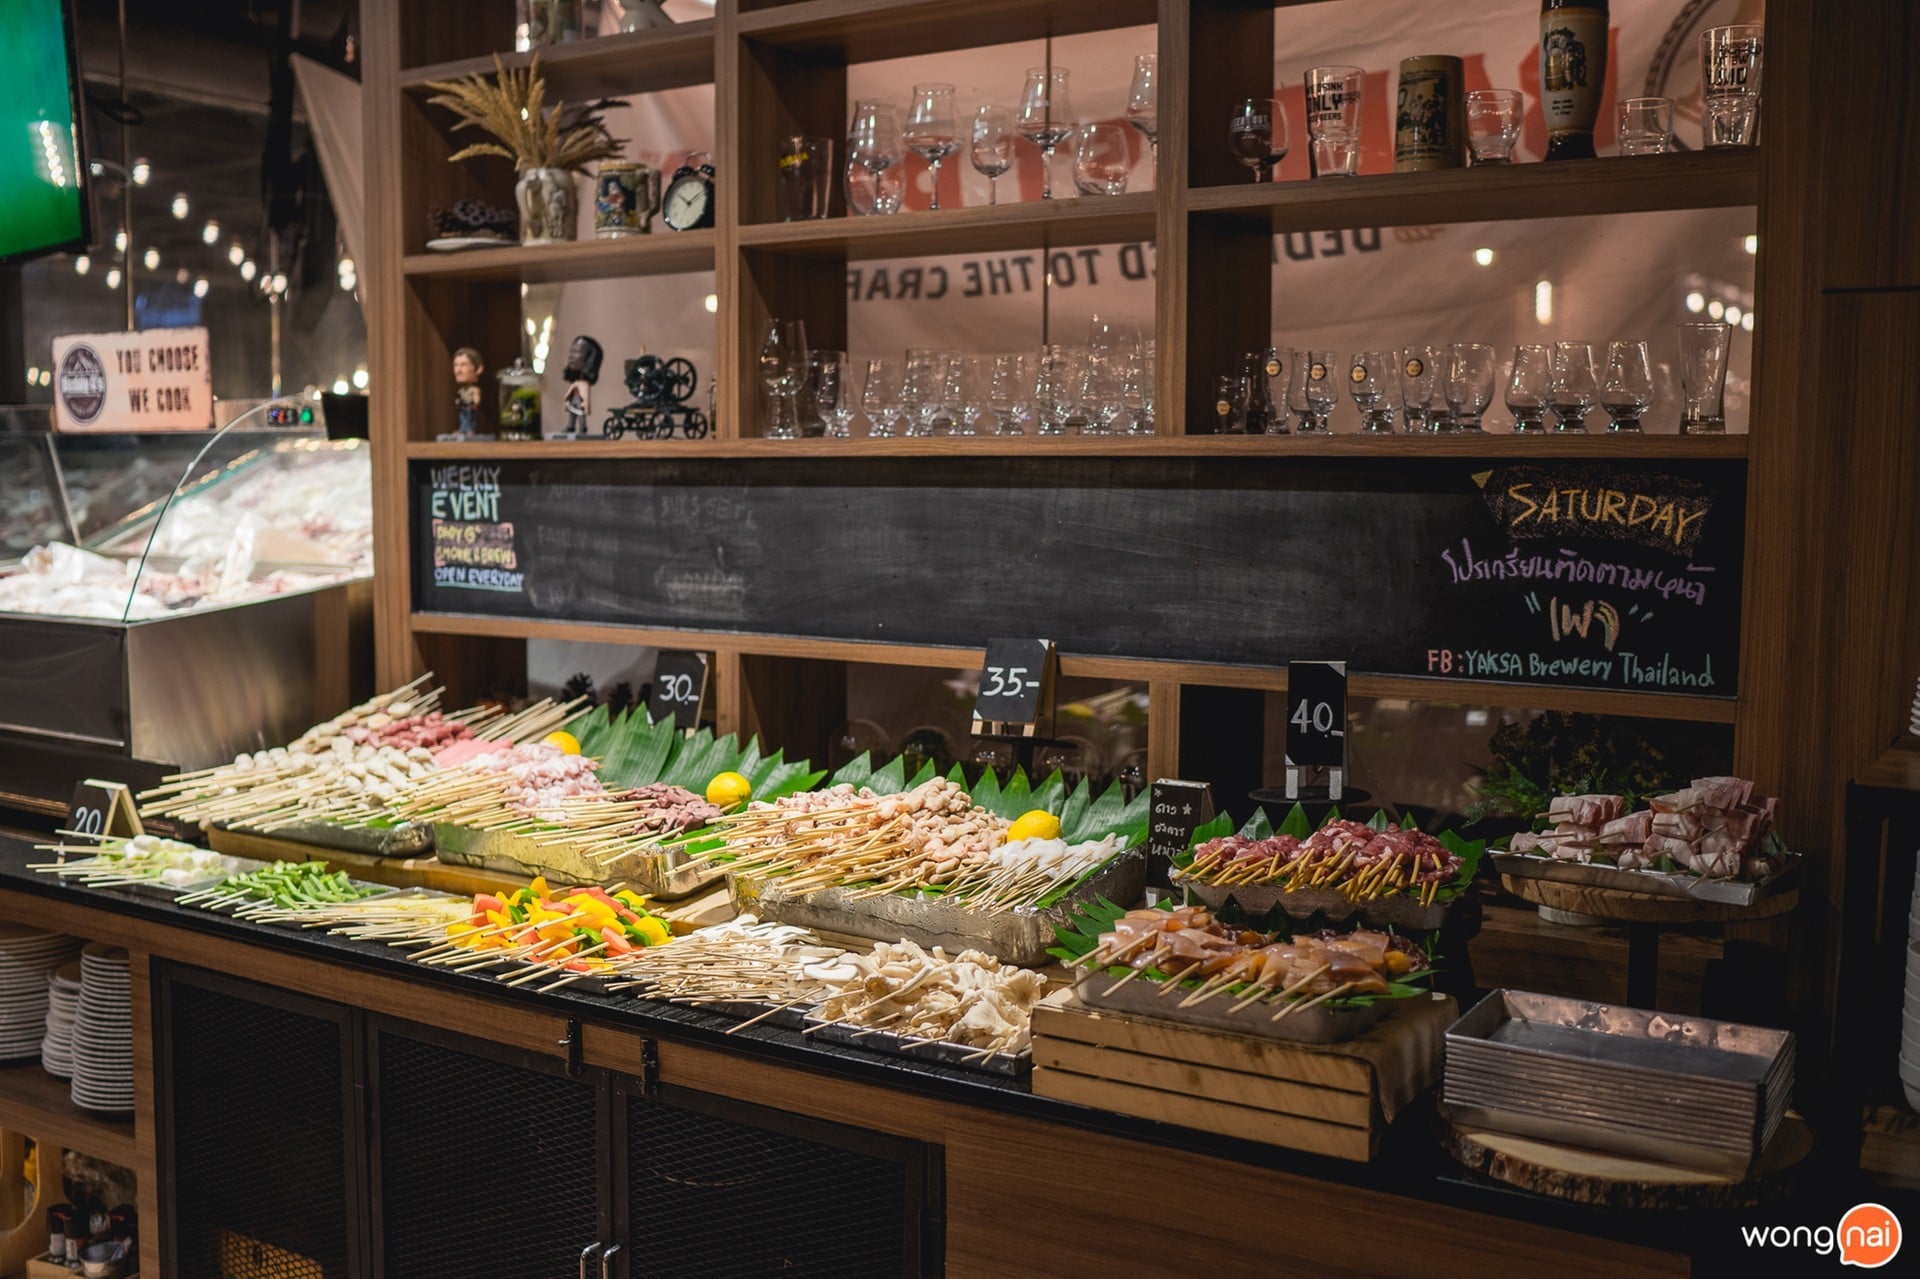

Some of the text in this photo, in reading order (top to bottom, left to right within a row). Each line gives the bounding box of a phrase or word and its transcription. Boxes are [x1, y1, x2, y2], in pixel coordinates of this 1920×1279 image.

[116, 344, 199, 374] YOU CHOOSE
[128, 386, 192, 413] WE COOK
[430, 465, 501, 492] WEEKLY
[431, 490, 502, 522] EVENT
[1508, 482, 1706, 546] SATURDAY
[434, 566, 524, 588] OPEN EVERYDAY
[1466, 650, 1523, 677] YAKSA
[1528, 654, 1613, 684] Brewery
[1619, 651, 1715, 687] Thailand
